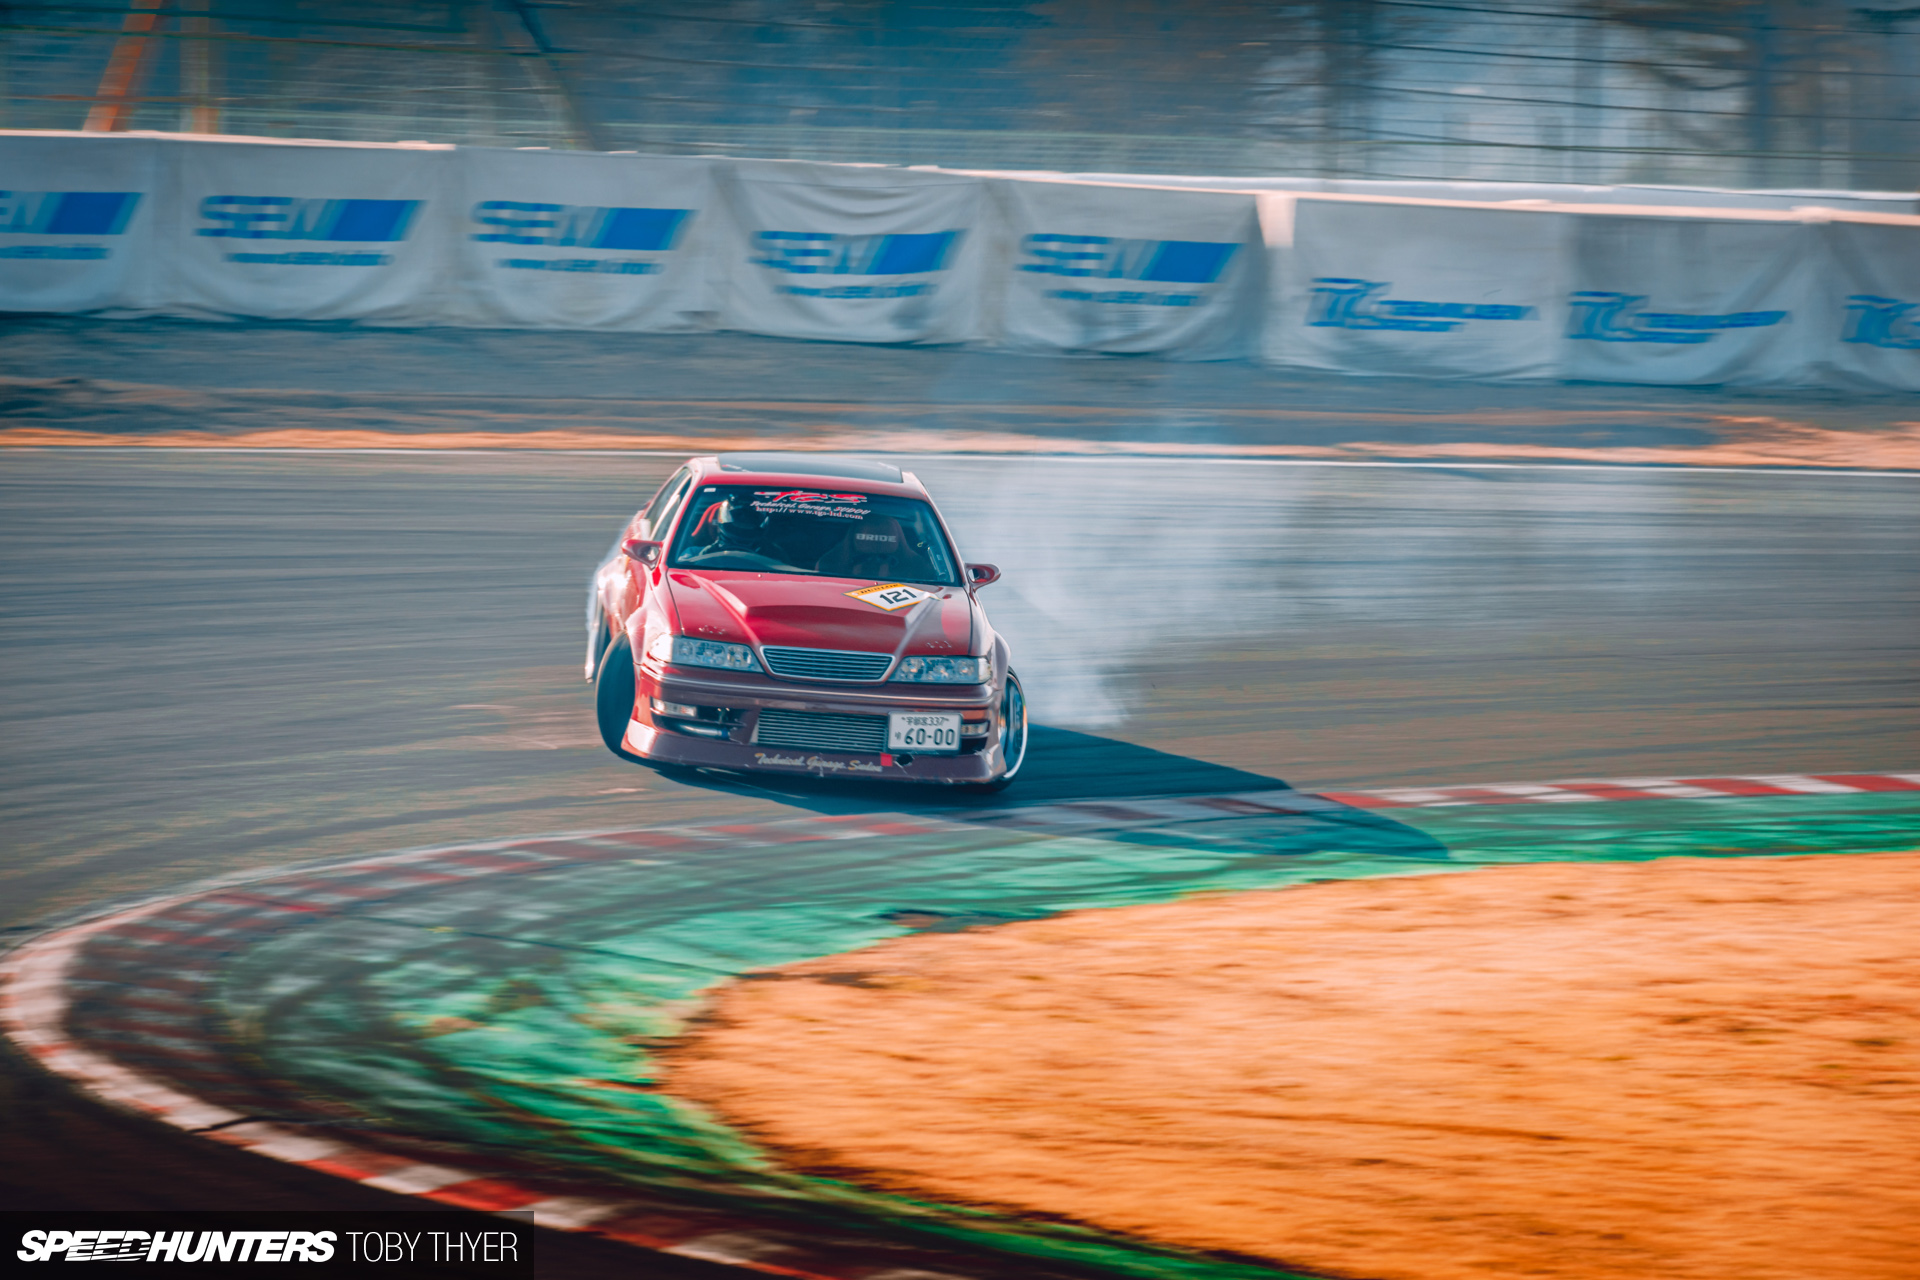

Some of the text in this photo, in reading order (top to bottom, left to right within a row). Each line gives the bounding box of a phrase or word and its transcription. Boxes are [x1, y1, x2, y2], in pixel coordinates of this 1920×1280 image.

[855, 533, 897, 543] BRIDE
[879, 589, 917, 605] 121
[904, 727, 955, 746] 60-00
